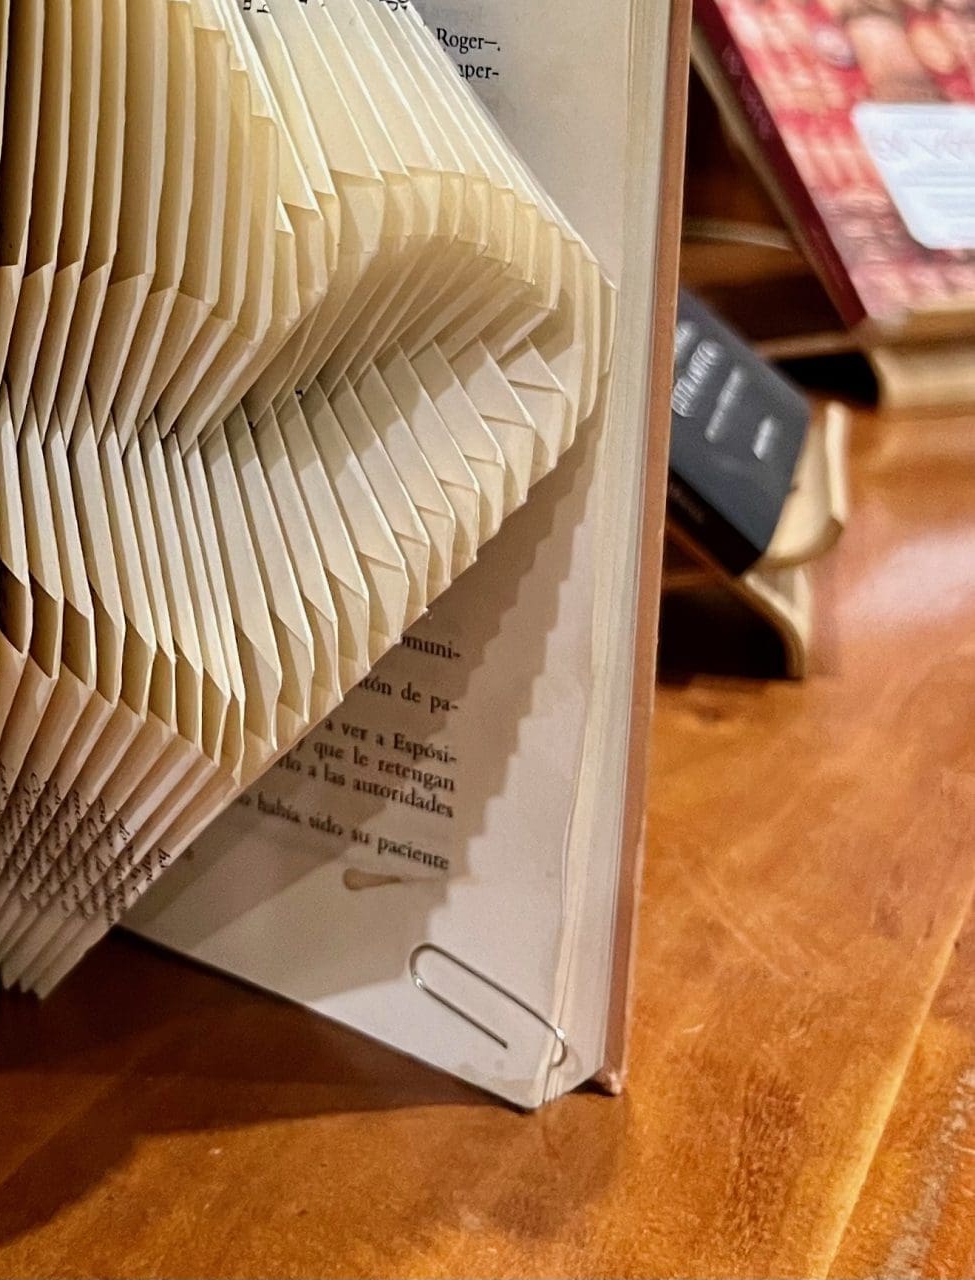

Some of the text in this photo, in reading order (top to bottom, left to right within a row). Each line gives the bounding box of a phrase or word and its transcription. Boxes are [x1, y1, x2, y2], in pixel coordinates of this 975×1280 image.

[400, 681, 423, 704] de
[429, 692, 459, 714] pa-
[341, 720, 368, 741] ver
[375, 734, 385, 747] a
[393, 731, 458, 765] Espósi-
[313, 738, 344, 762] que
[353, 745, 369, 767] le
[377, 755, 456, 793] retengan
[323, 761, 346, 786] las
[352, 775, 454, 819] autoridades
[350, 827, 371, 846] su
[377, 834, 451, 872] paciente
